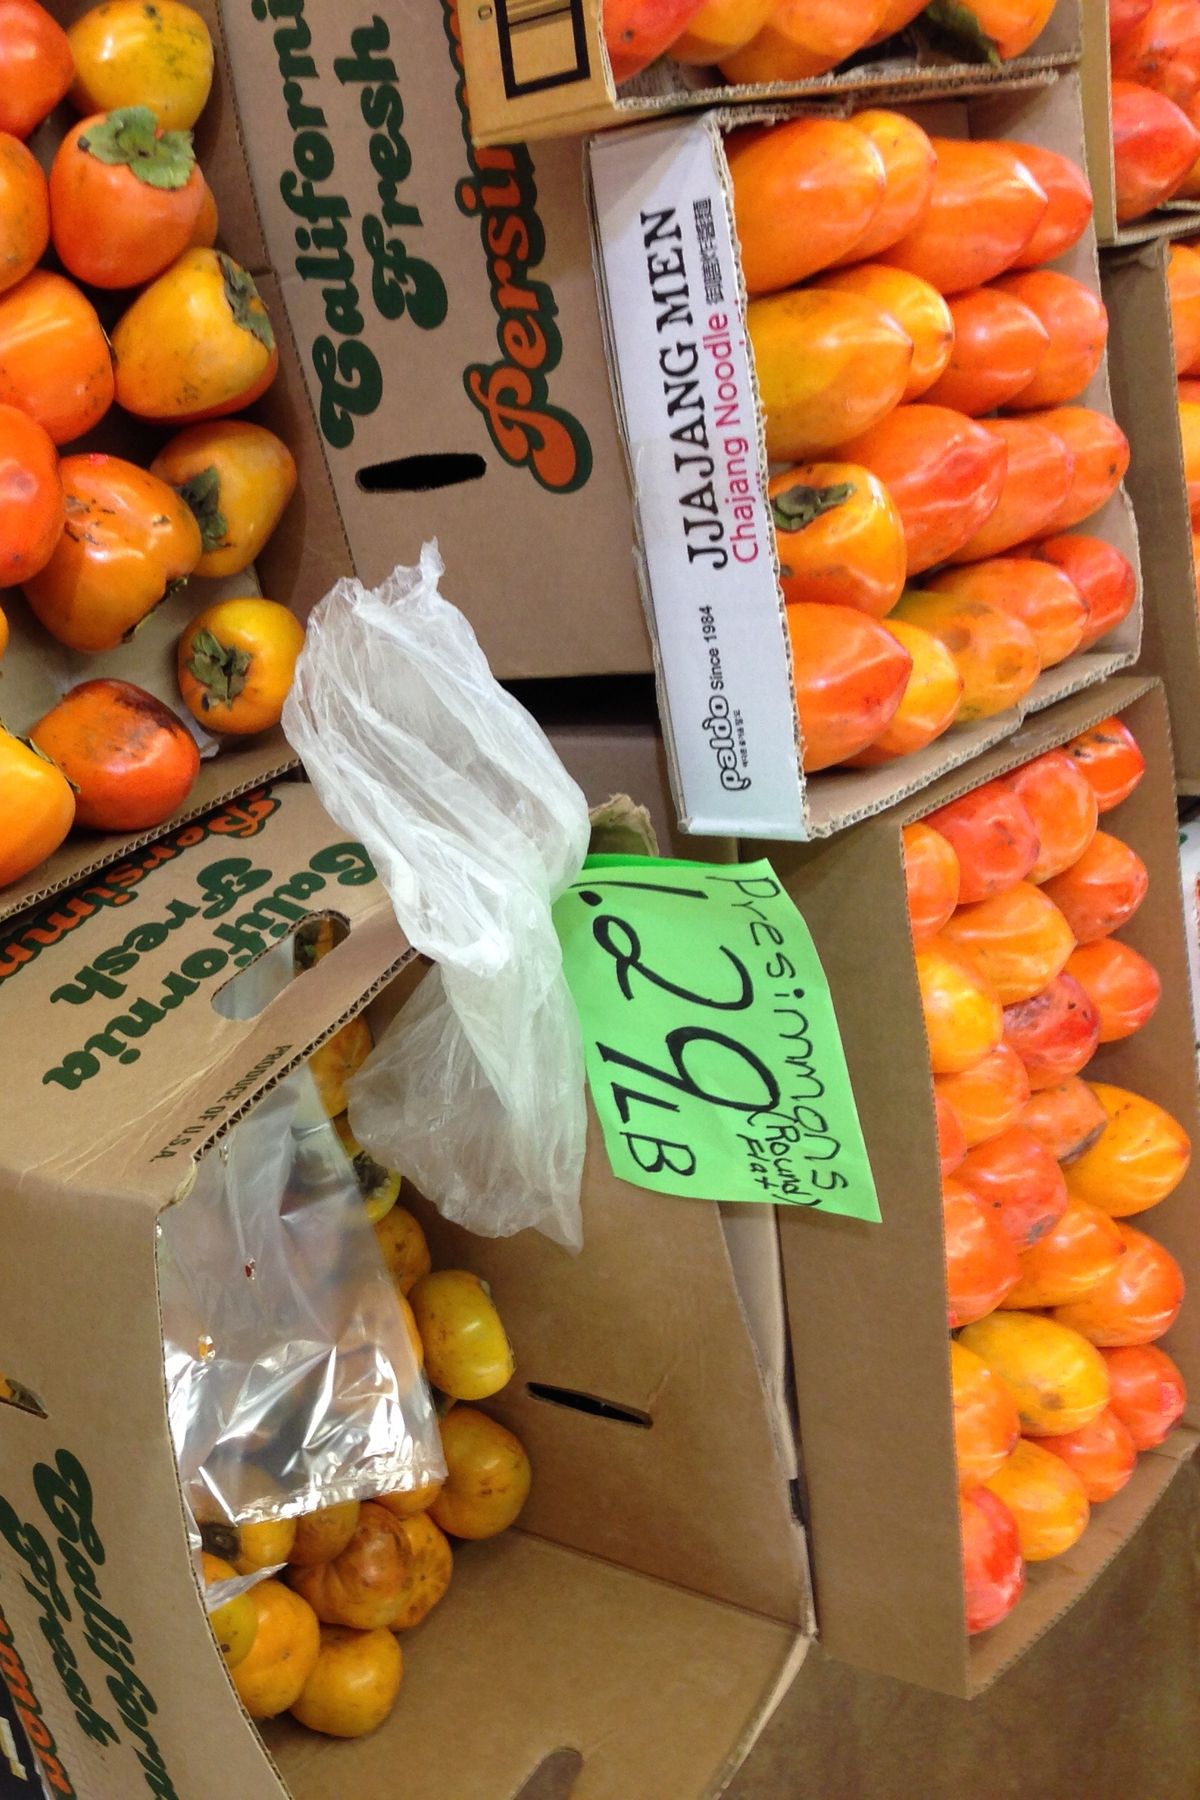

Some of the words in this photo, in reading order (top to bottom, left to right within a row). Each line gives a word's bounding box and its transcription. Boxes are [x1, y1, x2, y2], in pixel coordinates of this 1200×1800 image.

[246, 0, 385, 449] Californi
[333, 15, 449, 330] Fresh
[640, 207, 694, 333] MEN
[703, 312, 740, 428] Noodle
[658, 342, 729, 570] JJAJANG
[723, 436, 758, 563] Chajang
[699, 604, 717, 643] 1984
[710, 647, 724, 690] Since
[702, 695, 751, 791] paldo
[42, 842, 378, 1091] California
[50, 857, 273, 1005] Fresh
[198, 1105, 226, 1121] OF
[217, 1044, 294, 1103] PRODUCE
[149, 1125, 206, 1162] U.S.A.
[33, 1449, 178, 1800] Californ
